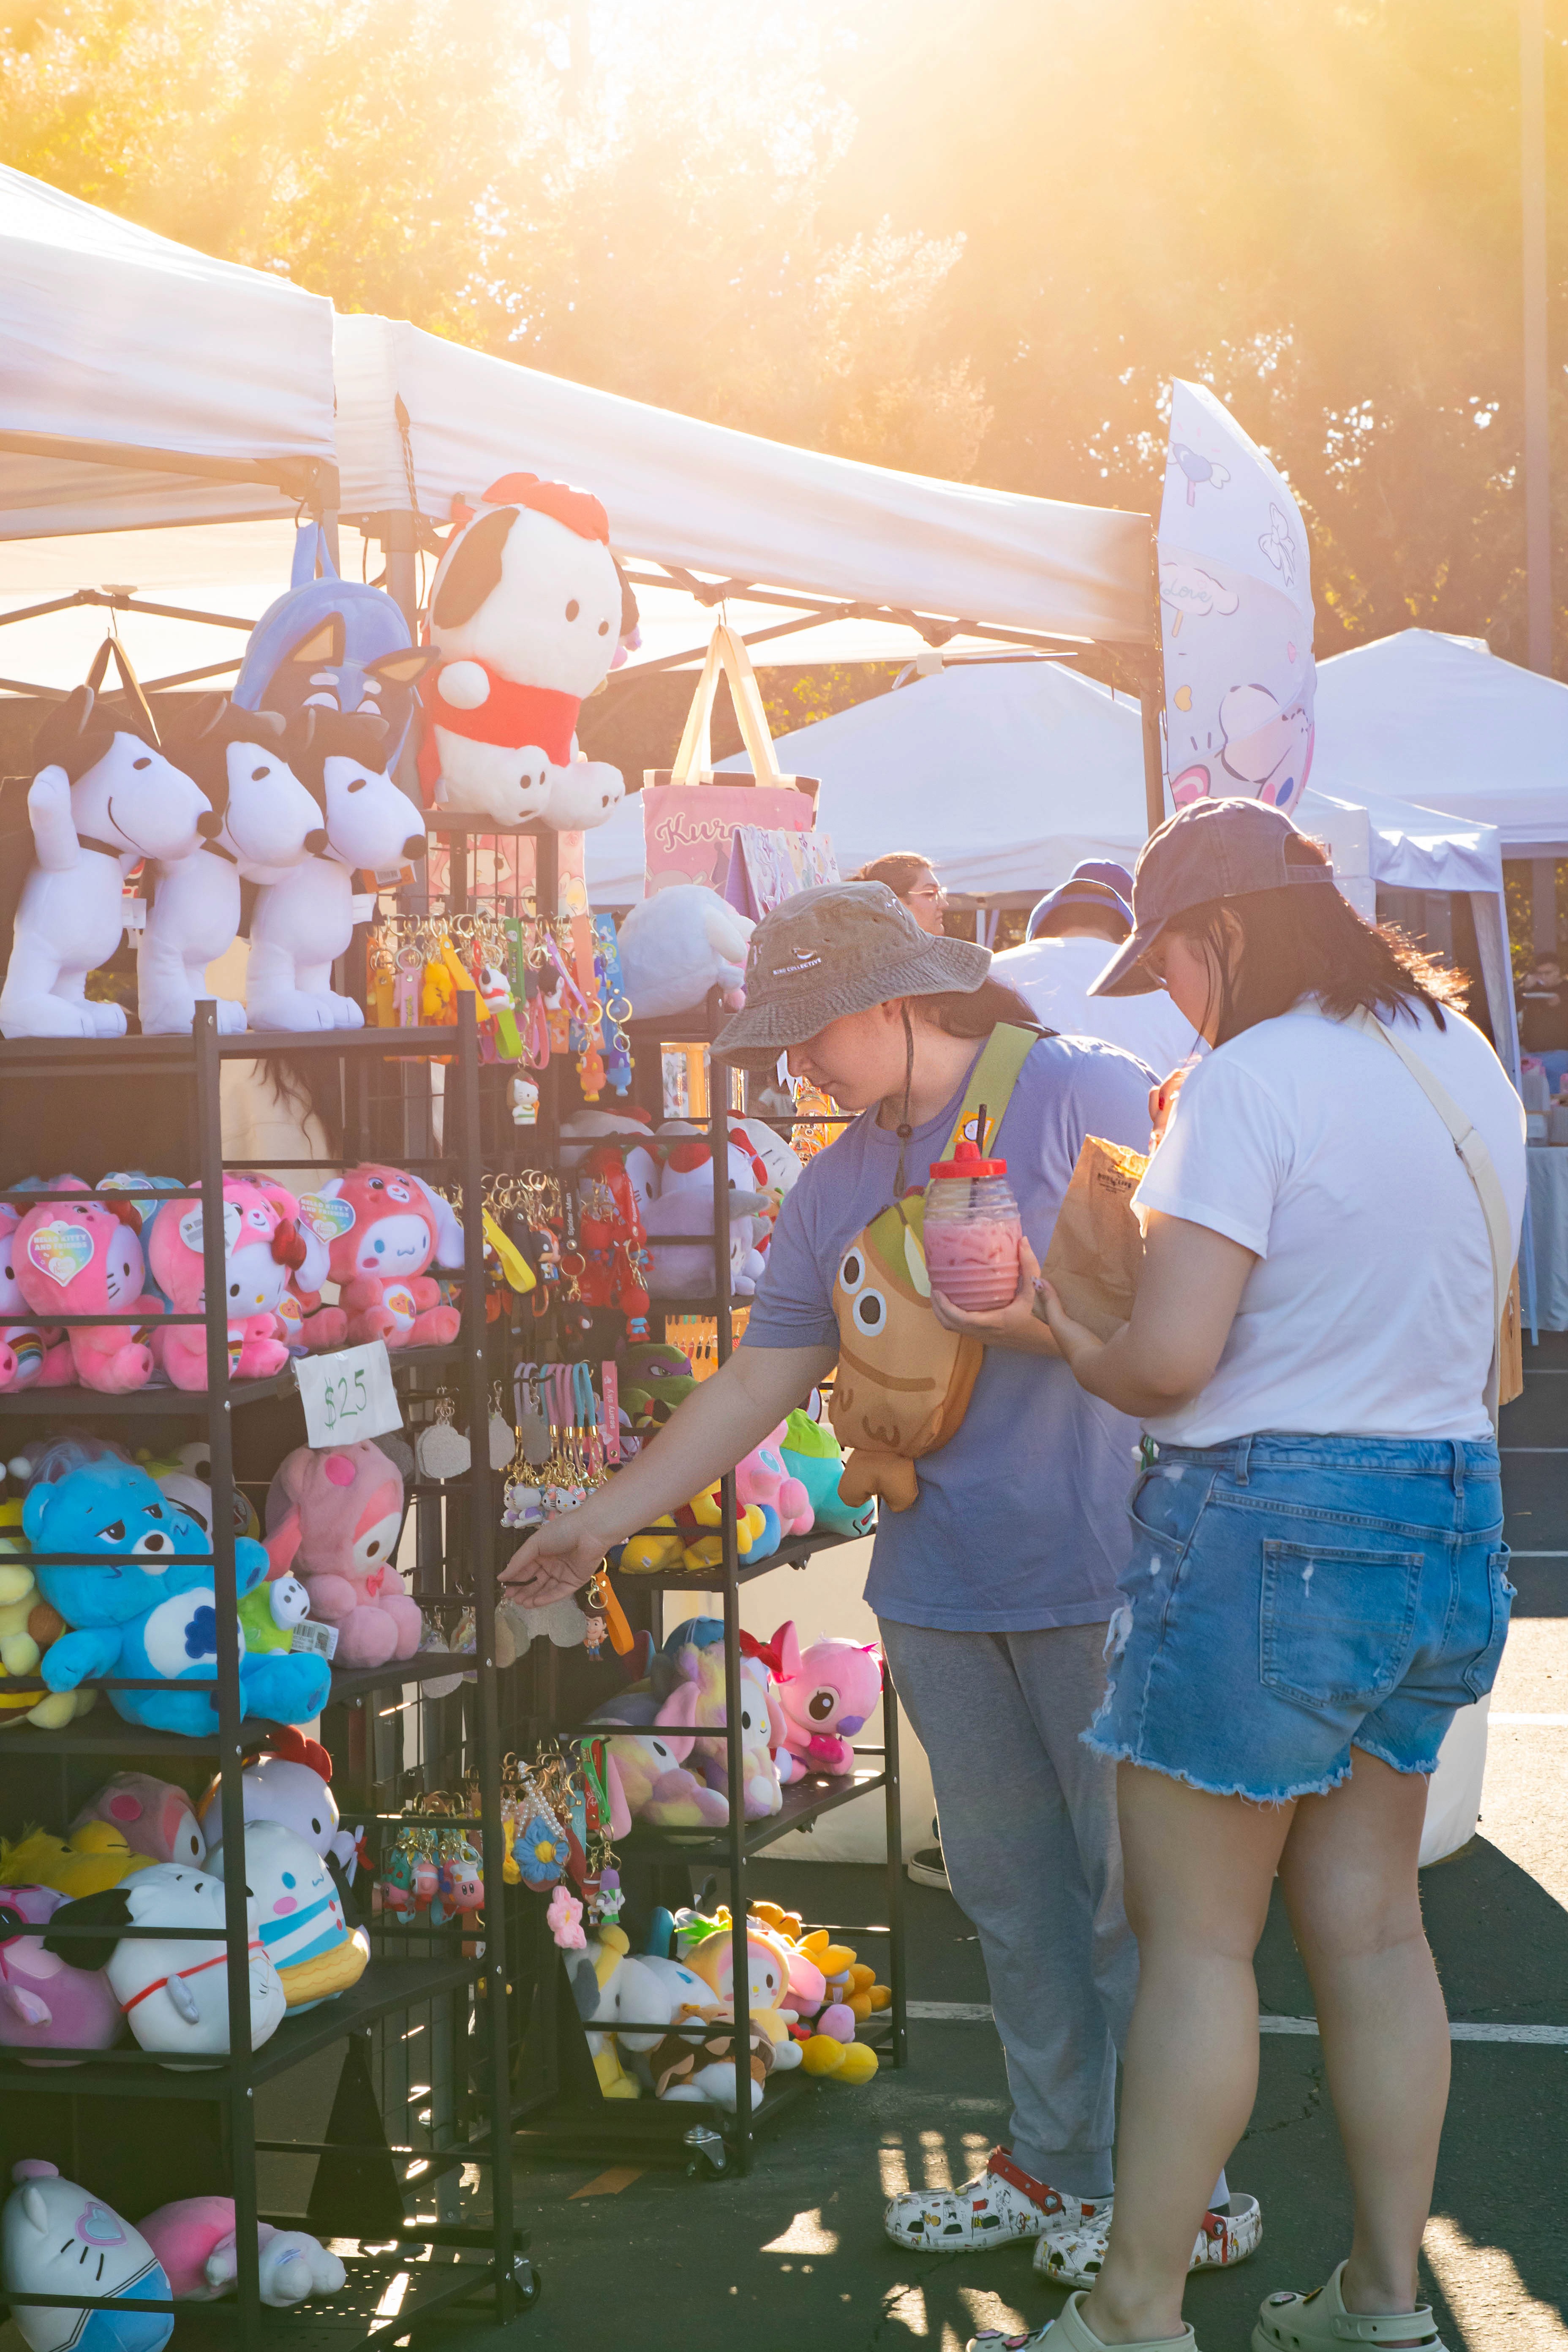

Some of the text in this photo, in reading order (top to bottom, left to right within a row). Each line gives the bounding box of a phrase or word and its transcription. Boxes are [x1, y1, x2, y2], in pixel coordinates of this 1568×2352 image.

[1162, 578, 1213, 602] Love
[787, 958, 821, 972] COLLECTIVE
[300, 1198, 349, 1211] HELLO KITTY
[318, 1209, 349, 1217] FRIENDS
[566, 1193, 575, 1236] Spider-Man
[53, 1241, 87, 1250] FRIENDS
[324, 1369, 367, 1430] $25
